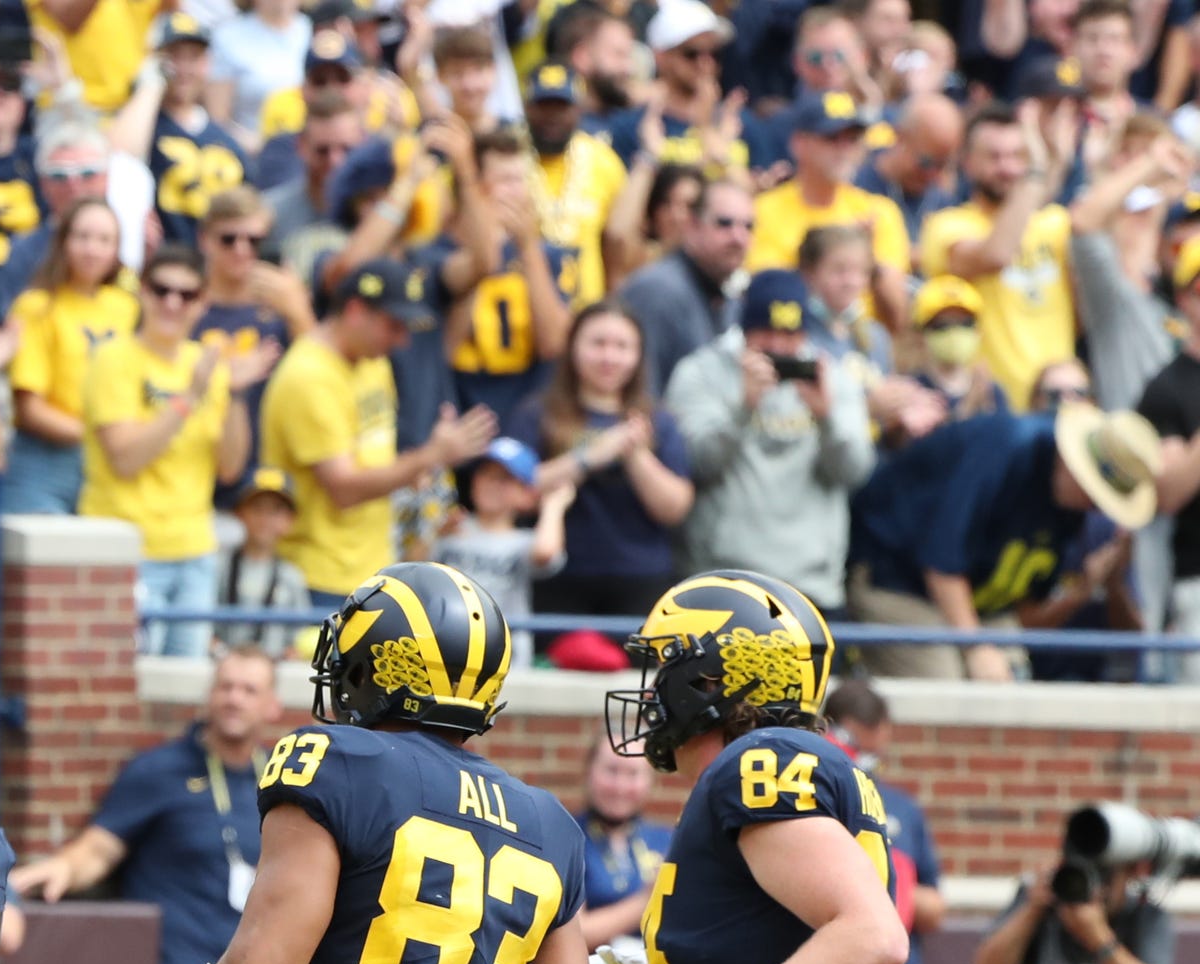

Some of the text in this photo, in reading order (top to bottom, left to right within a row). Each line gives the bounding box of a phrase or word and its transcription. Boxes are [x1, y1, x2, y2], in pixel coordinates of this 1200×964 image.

[403, 697, 420, 713] 83
[259, 733, 330, 790] 83
[739, 748, 819, 811] 84
[458, 769, 518, 833] ALL
